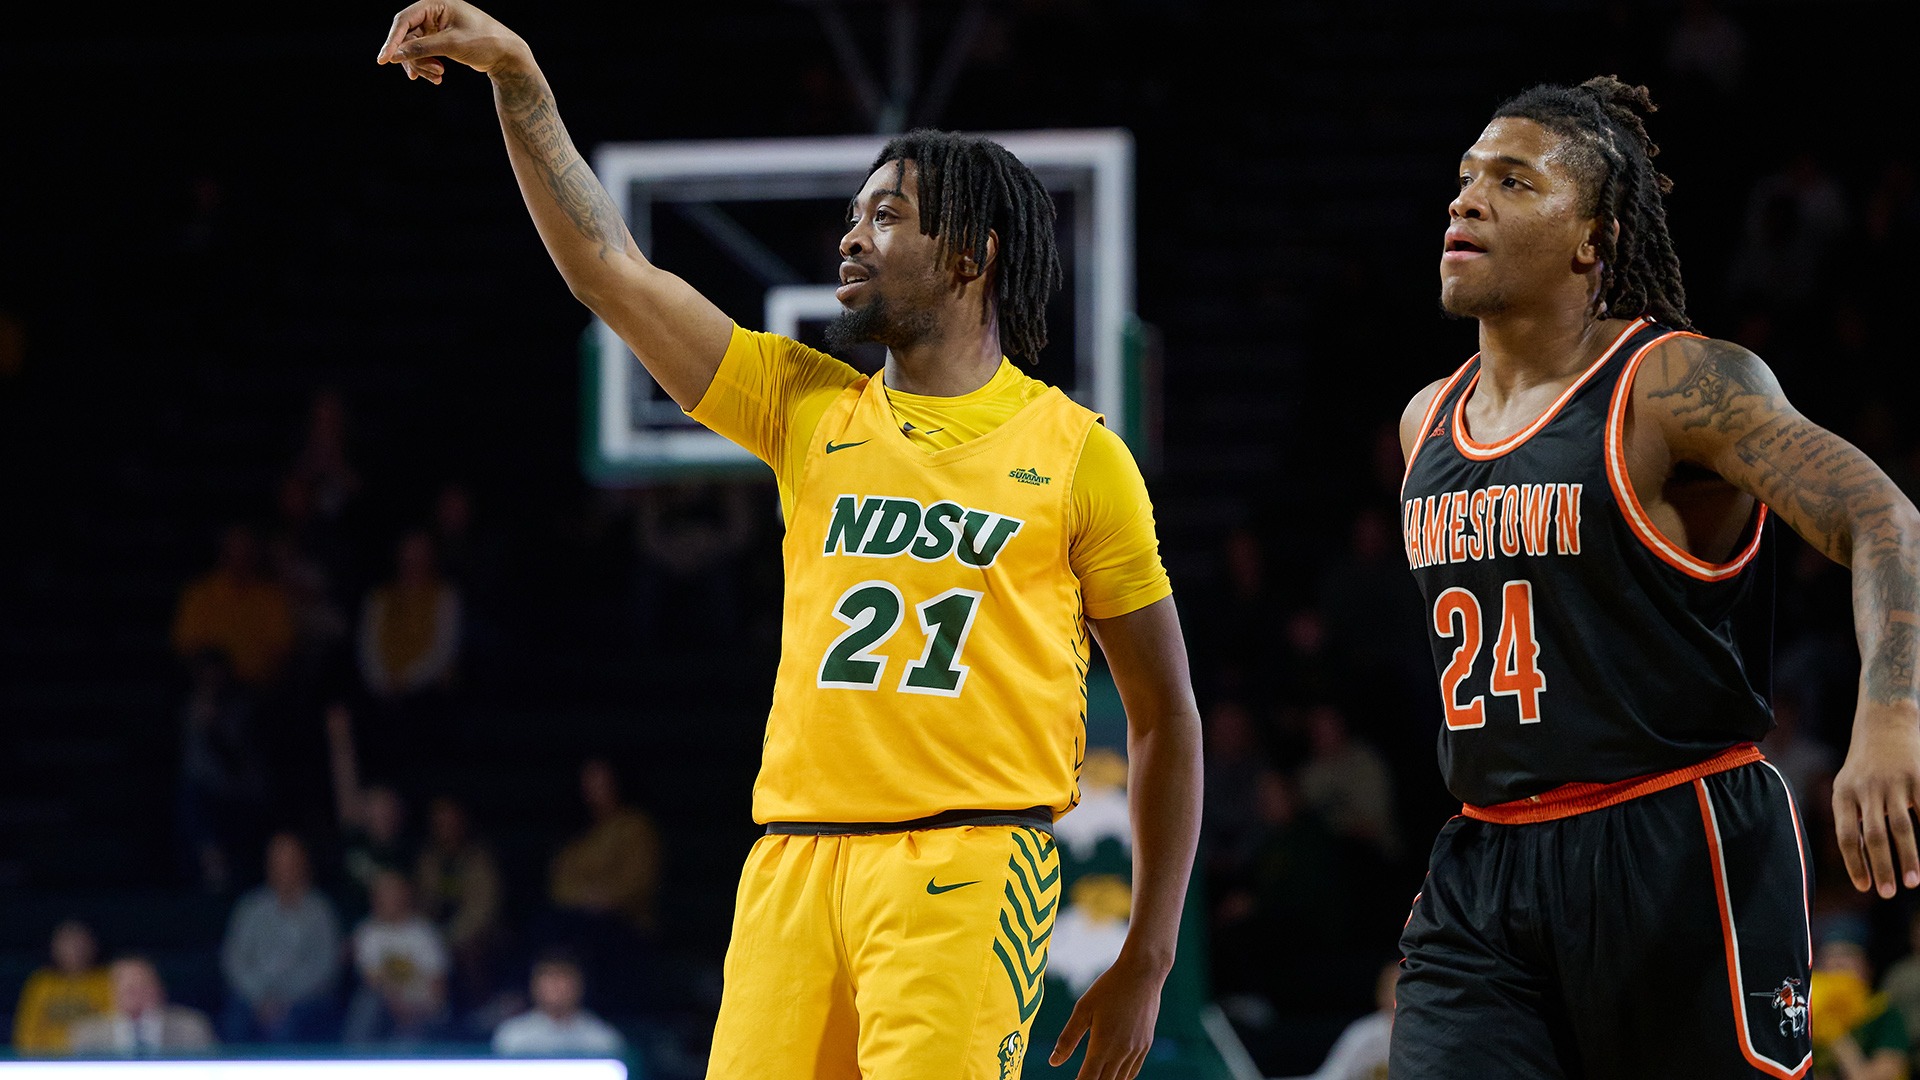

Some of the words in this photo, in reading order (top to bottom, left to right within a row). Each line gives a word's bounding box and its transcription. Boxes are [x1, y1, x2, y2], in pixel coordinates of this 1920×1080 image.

[1009, 471, 1051, 484] SUMMIT
[823, 494, 1026, 569] NDSU
[816, 579, 985, 698] 21
[1433, 579, 1547, 731] 24
